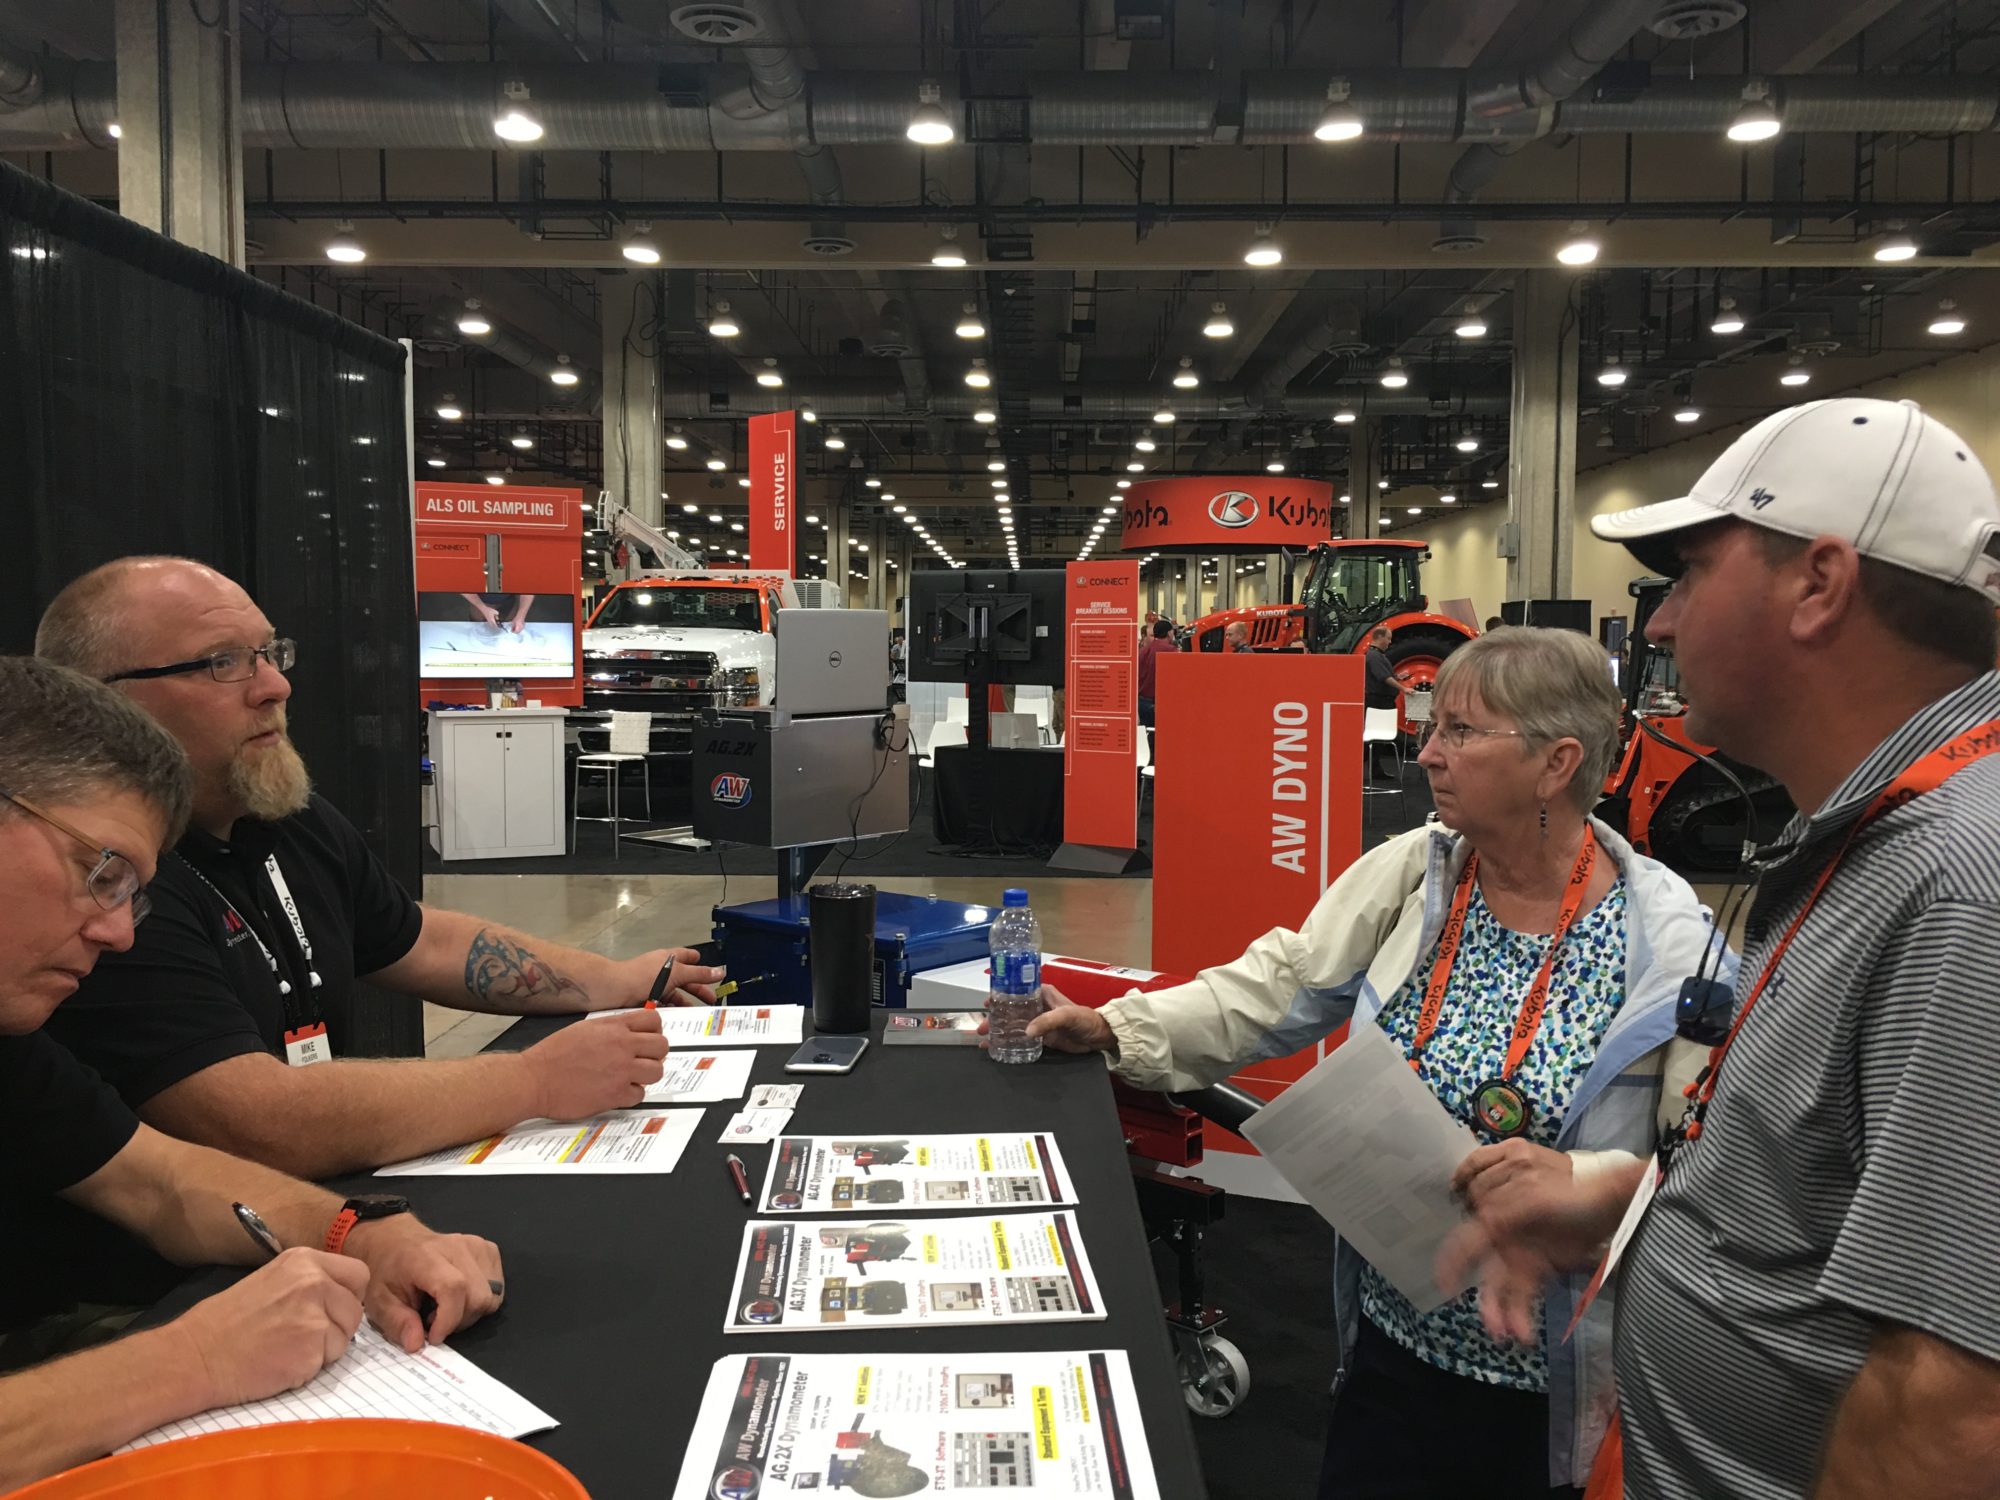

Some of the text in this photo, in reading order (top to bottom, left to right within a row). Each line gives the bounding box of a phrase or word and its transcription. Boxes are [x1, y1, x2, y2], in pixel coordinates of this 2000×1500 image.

[774, 452, 785, 531] SERVICE
[426, 498, 554, 516] ALS OIL SAMPLING
[1124, 500, 1169, 530] bota
[1268, 496, 1330, 527] Kubo
[433, 543, 470, 551] CONNECT
[1089, 577, 1130, 586] CONNECT
[706, 740, 758, 756] AG.2X
[714, 776, 750, 798] AW
[1271, 701, 1309, 874] AW DYNO
[284, 897, 310, 951] Kubota
[1440, 908, 1464, 960] Kubota
[1417, 983, 1443, 1035] Kubota
[1517, 984, 1547, 1040] Kubota
[301, 1041, 316, 1054] MIKE
[761, 1244, 777, 1283] Dynamometer
[789, 1236, 812, 1311] AG.3X Dynamometer
[740, 1379, 770, 1441] Dynamometer
[1037, 1388, 1046, 1402] Terms
[770, 1371, 808, 1481] AG.2X Dynamometer
[1038, 1408, 1052, 1434] Equipment
[736, 1443, 752, 1461] AW
[1041, 1436, 1053, 1459] Standard
